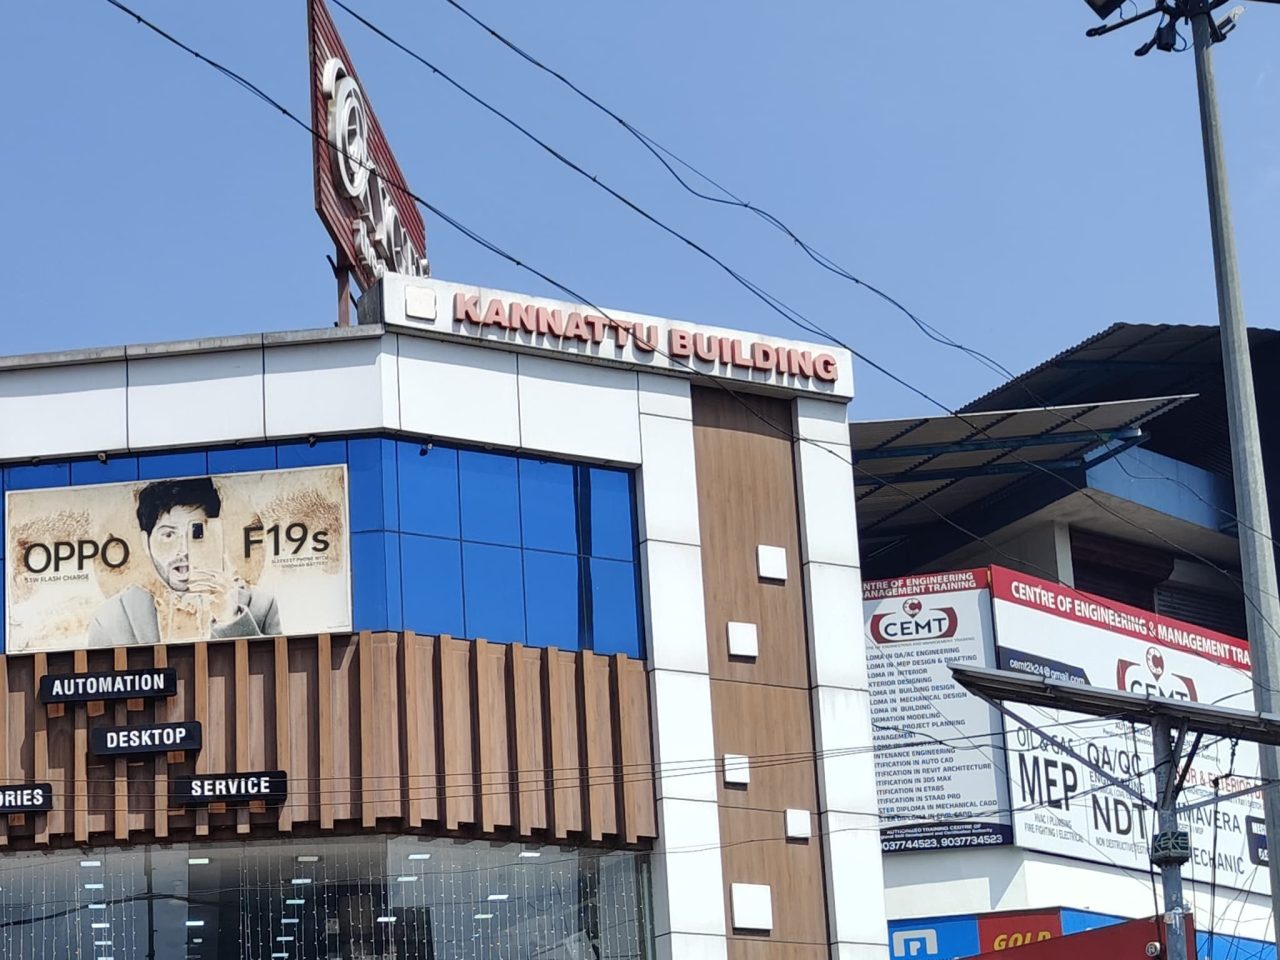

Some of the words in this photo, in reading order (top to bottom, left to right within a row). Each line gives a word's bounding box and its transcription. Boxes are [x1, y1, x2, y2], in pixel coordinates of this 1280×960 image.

[453, 291, 659, 353] KANNATTU
[668, 327, 839, 383] BUILDING
[243, 522, 329, 558] F19s
[23, 537, 130, 574] OPPO
[62, 573, 89, 581] CHARGE
[890, 579, 904, 588] OF
[906, 571, 974, 586] ENGINEERING
[927, 580, 977, 592] TRAINING
[1011, 580, 1056, 609] CENTRE
[1057, 594, 1073, 613] OF
[1074, 599, 1148, 636] ENGINEERING
[1148, 621, 1157, 637] &
[1157, 623, 1230, 660] MANAGEMENT
[884, 617, 947, 637] CEMT
[916, 646, 960, 657] ENGINEERING
[911, 657, 936, 666] DESIGN
[897, 668, 928, 677] INTERIOR
[52, 672, 165, 696] AUTOMATION
[898, 686, 930, 695] BUILDING
[899, 694, 941, 704] MECHANICAL
[942, 691, 968, 700] DESIGN
[900, 704, 932, 713] BUILDING
[906, 712, 941, 721] MODELING
[902, 721, 931, 730] PROJECT
[931, 719, 966, 728] PLANNING
[106, 727, 186, 749] DESKTOP
[911, 748, 956, 757] ENGINEERING
[921, 758, 940, 766] AUTO
[940, 756, 954, 764] CAD
[1086, 742, 1142, 778] QA/QC
[921, 766, 942, 775] REVIT
[942, 762, 992, 773] ARCHITECTURE
[191, 776, 271, 797] SERVICE
[923, 784, 945, 792] ETABS
[1018, 752, 1078, 812] MEP
[924, 794, 946, 802] STAAD
[896, 804, 926, 812] DIPLOMA
[935, 801, 978, 810] MECHANICAL
[1091, 793, 1149, 840] NDT
[941, 834, 1003, 847] 9037734523
